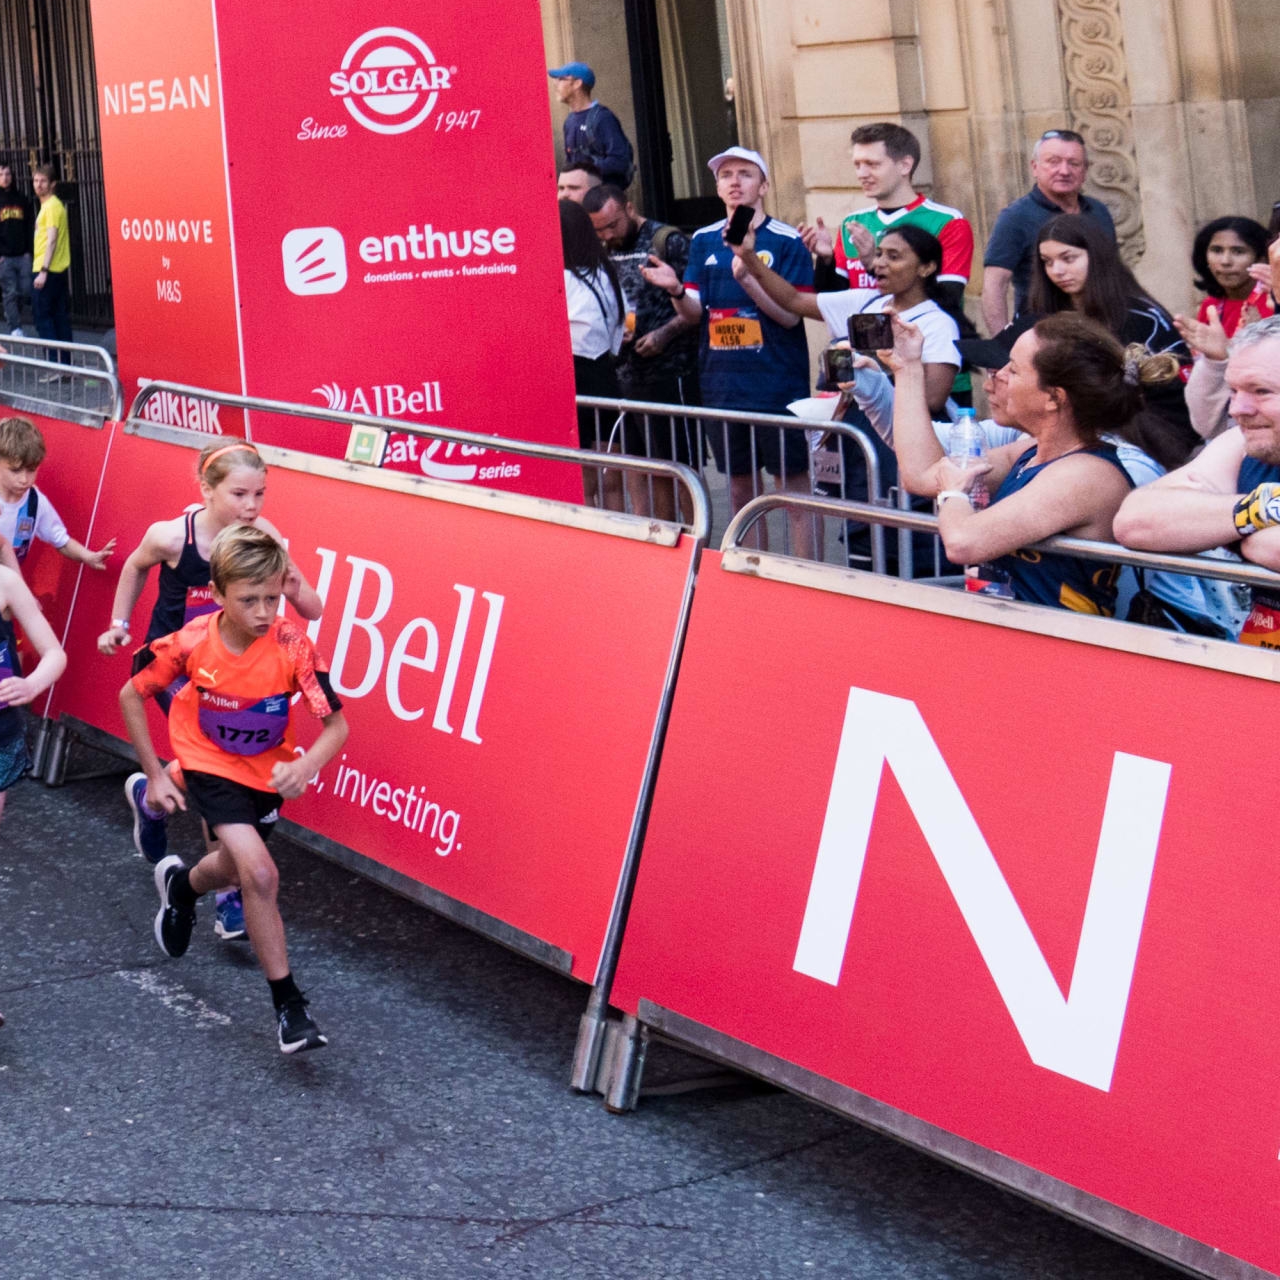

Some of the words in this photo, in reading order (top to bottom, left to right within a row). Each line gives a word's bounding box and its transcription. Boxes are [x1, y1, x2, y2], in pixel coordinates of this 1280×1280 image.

[103, 74, 211, 116] NISSAN
[296, 117, 349, 141] Since
[434, 109, 481, 132] 1947
[121, 217, 213, 243] GOODMOVE
[359, 223, 516, 264] enthuse
[161, 255, 171, 270] by
[363, 271, 413, 284] donations
[421, 268, 454, 279] events
[462, 262, 517, 275] fundraising
[156, 279, 182, 303] M&S
[478, 462, 521, 480] series
[216, 724, 270, 744] 1772
[333, 753, 463, 857] investing.
